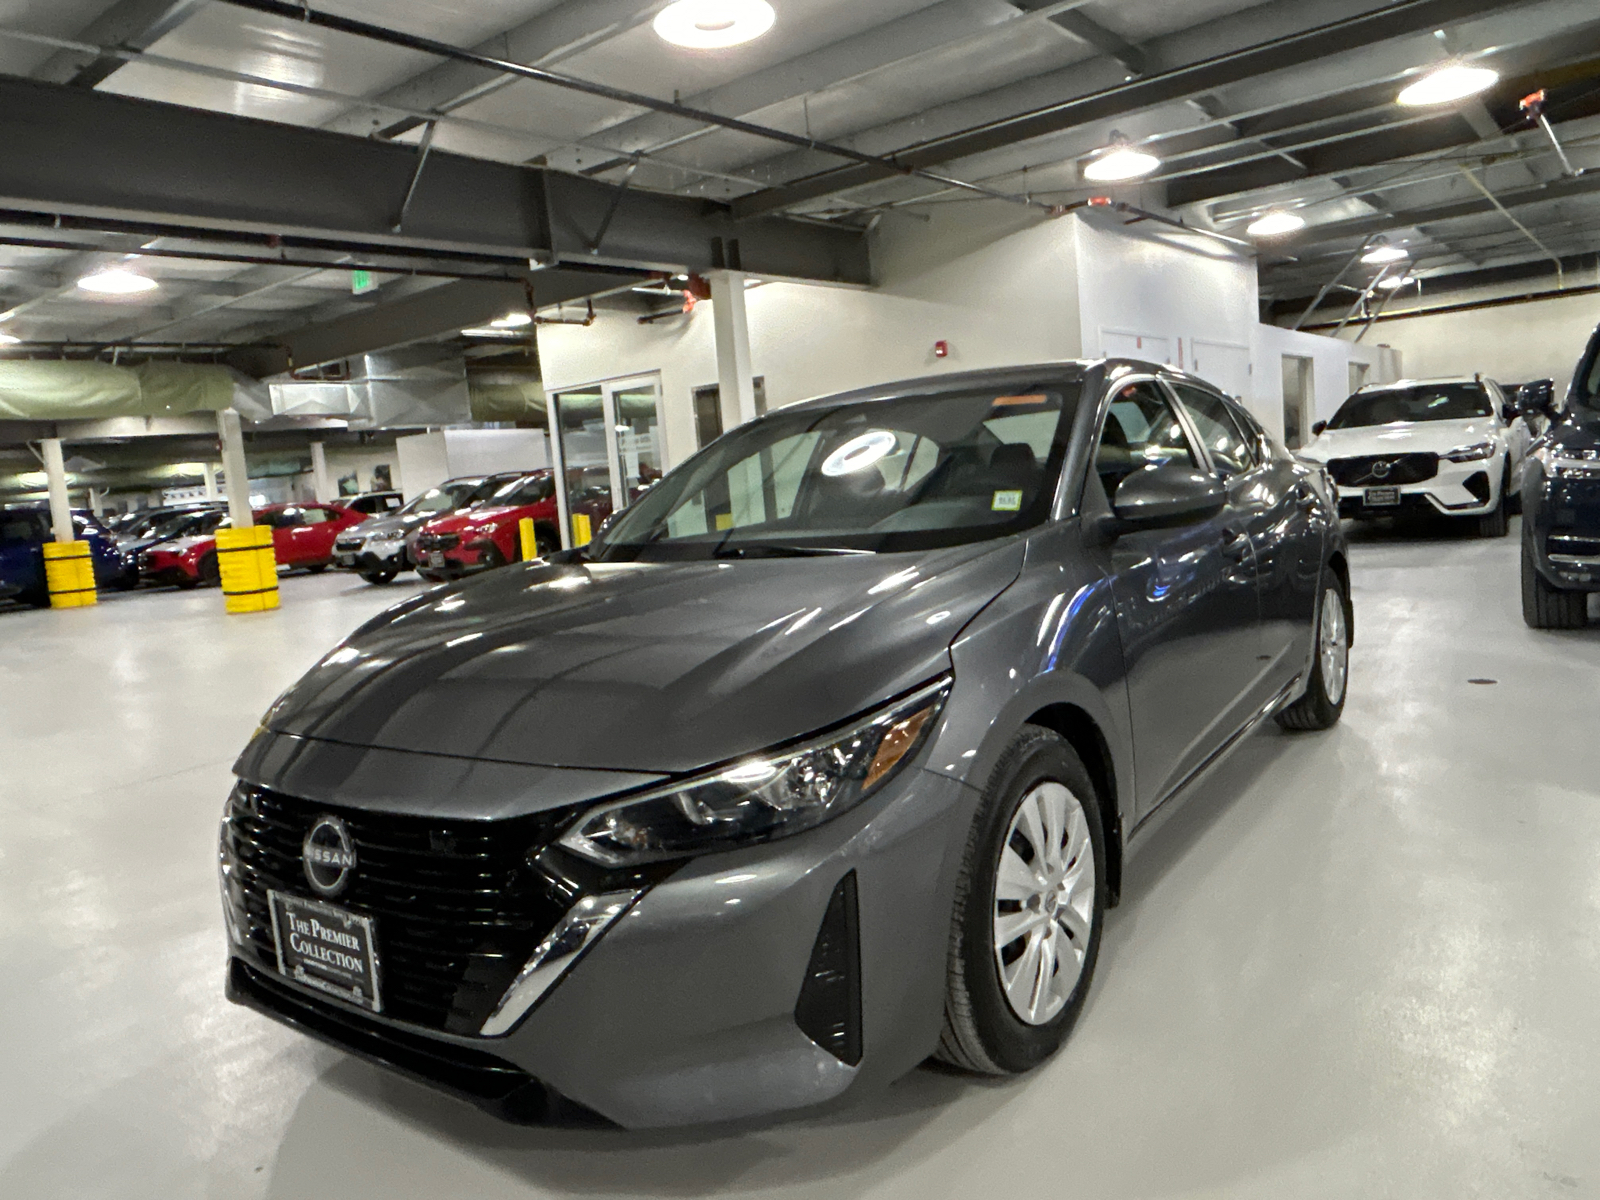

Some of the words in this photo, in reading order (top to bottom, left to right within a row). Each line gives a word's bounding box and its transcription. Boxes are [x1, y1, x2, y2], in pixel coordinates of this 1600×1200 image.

[285, 911, 311, 936] THE
[310, 918, 360, 952] PREMIER
[289, 932, 364, 974] COLLECTION
